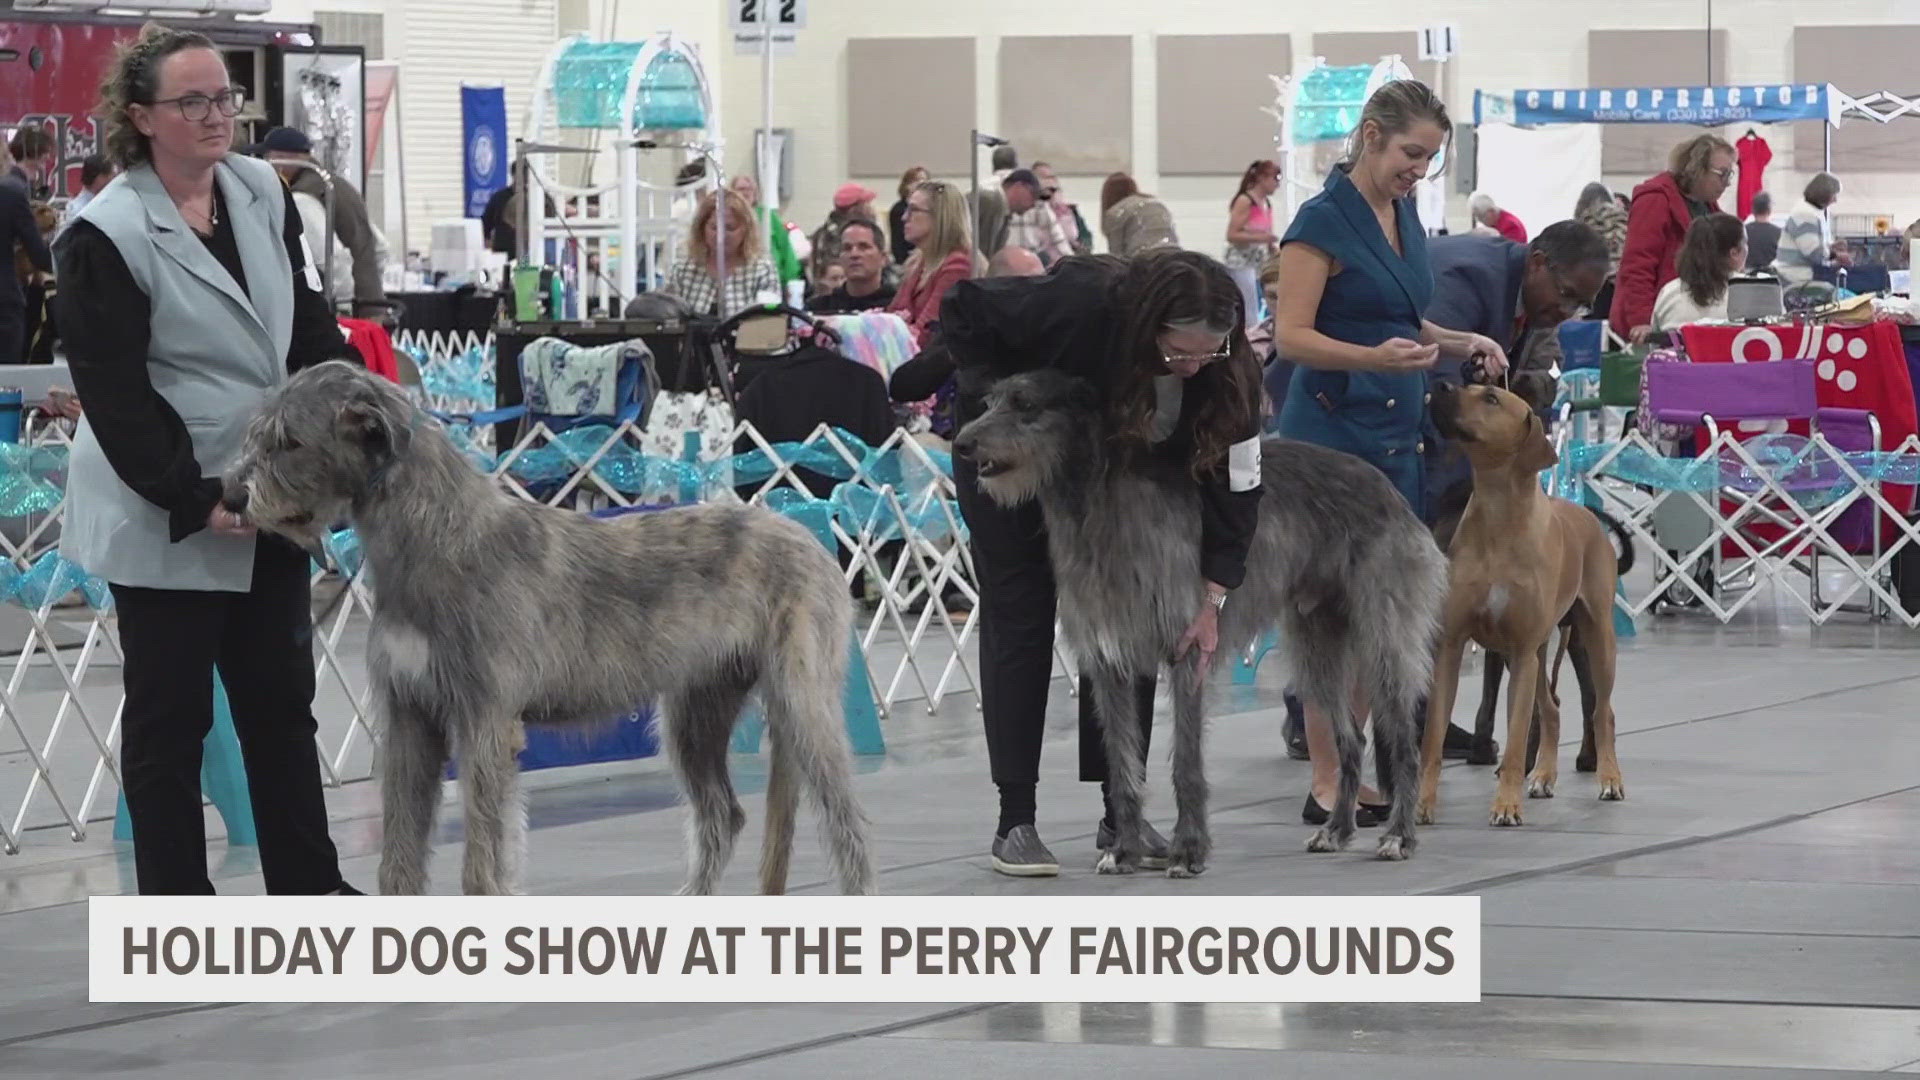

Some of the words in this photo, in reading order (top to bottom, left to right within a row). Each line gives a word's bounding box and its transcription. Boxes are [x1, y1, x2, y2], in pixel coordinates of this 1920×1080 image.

[741, 0, 756, 22] 2
[779, 0, 795, 22] 2
[1526, 85, 1818, 110] CHIROPRACTOR
[1633, 108, 1661, 121] Care
